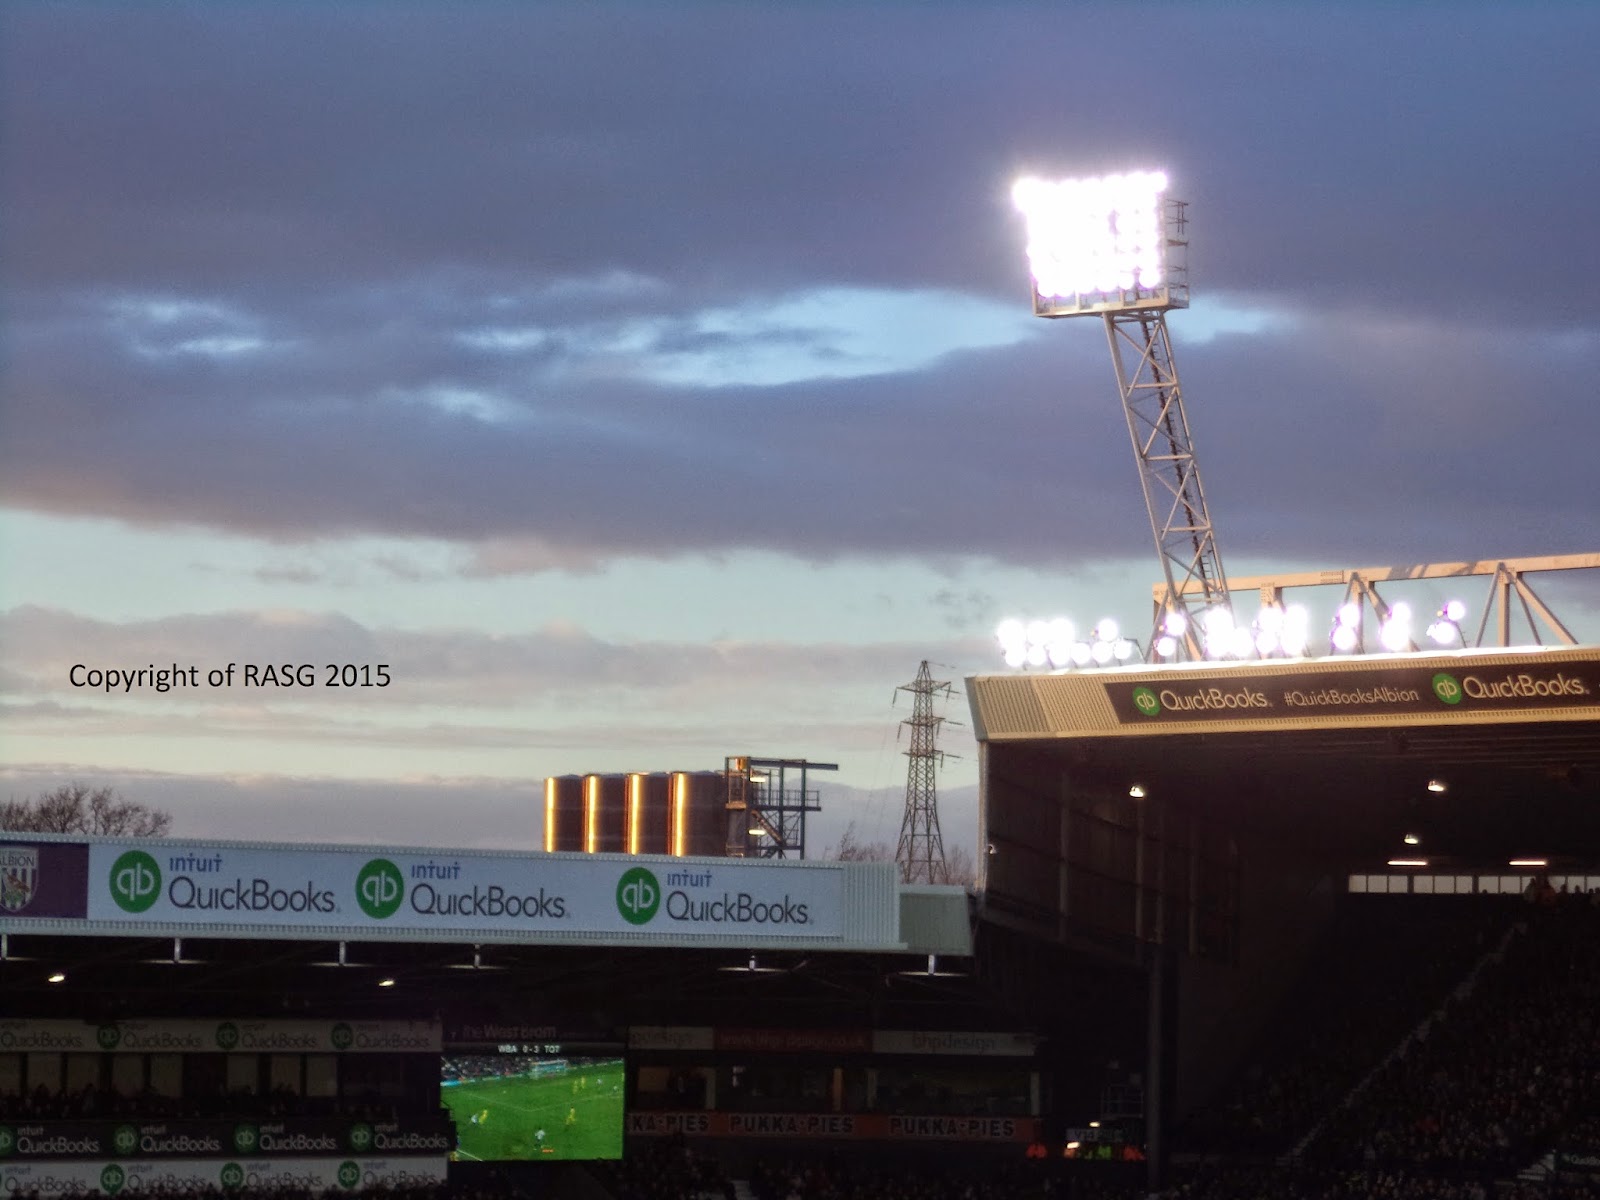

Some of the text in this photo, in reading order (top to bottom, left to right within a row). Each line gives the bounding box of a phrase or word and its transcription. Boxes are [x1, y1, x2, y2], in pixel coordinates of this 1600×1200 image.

[1160, 687, 1268, 711] QuickBooks
[1284, 687, 1419, 706] #QuickBooksAlbion
[1463, 673, 1584, 699] QuickBooks
[169, 853, 222, 873] intuit
[412, 861, 461, 879] intuit
[667, 869, 712, 888] intuit
[168, 876, 335, 914] QuickBooks
[410, 883, 565, 918] QuickBooks
[666, 890, 808, 925] QuickBooks
[498, 1045, 517, 1053] WBA
[544, 1045, 560, 1053] TOT
[17, 1136, 100, 1153] QuickBooks
[140, 1135, 221, 1152] QuickBooks
[259, 1132, 336, 1150] QuickBooks
[374, 1133, 449, 1149] QuickBooks
